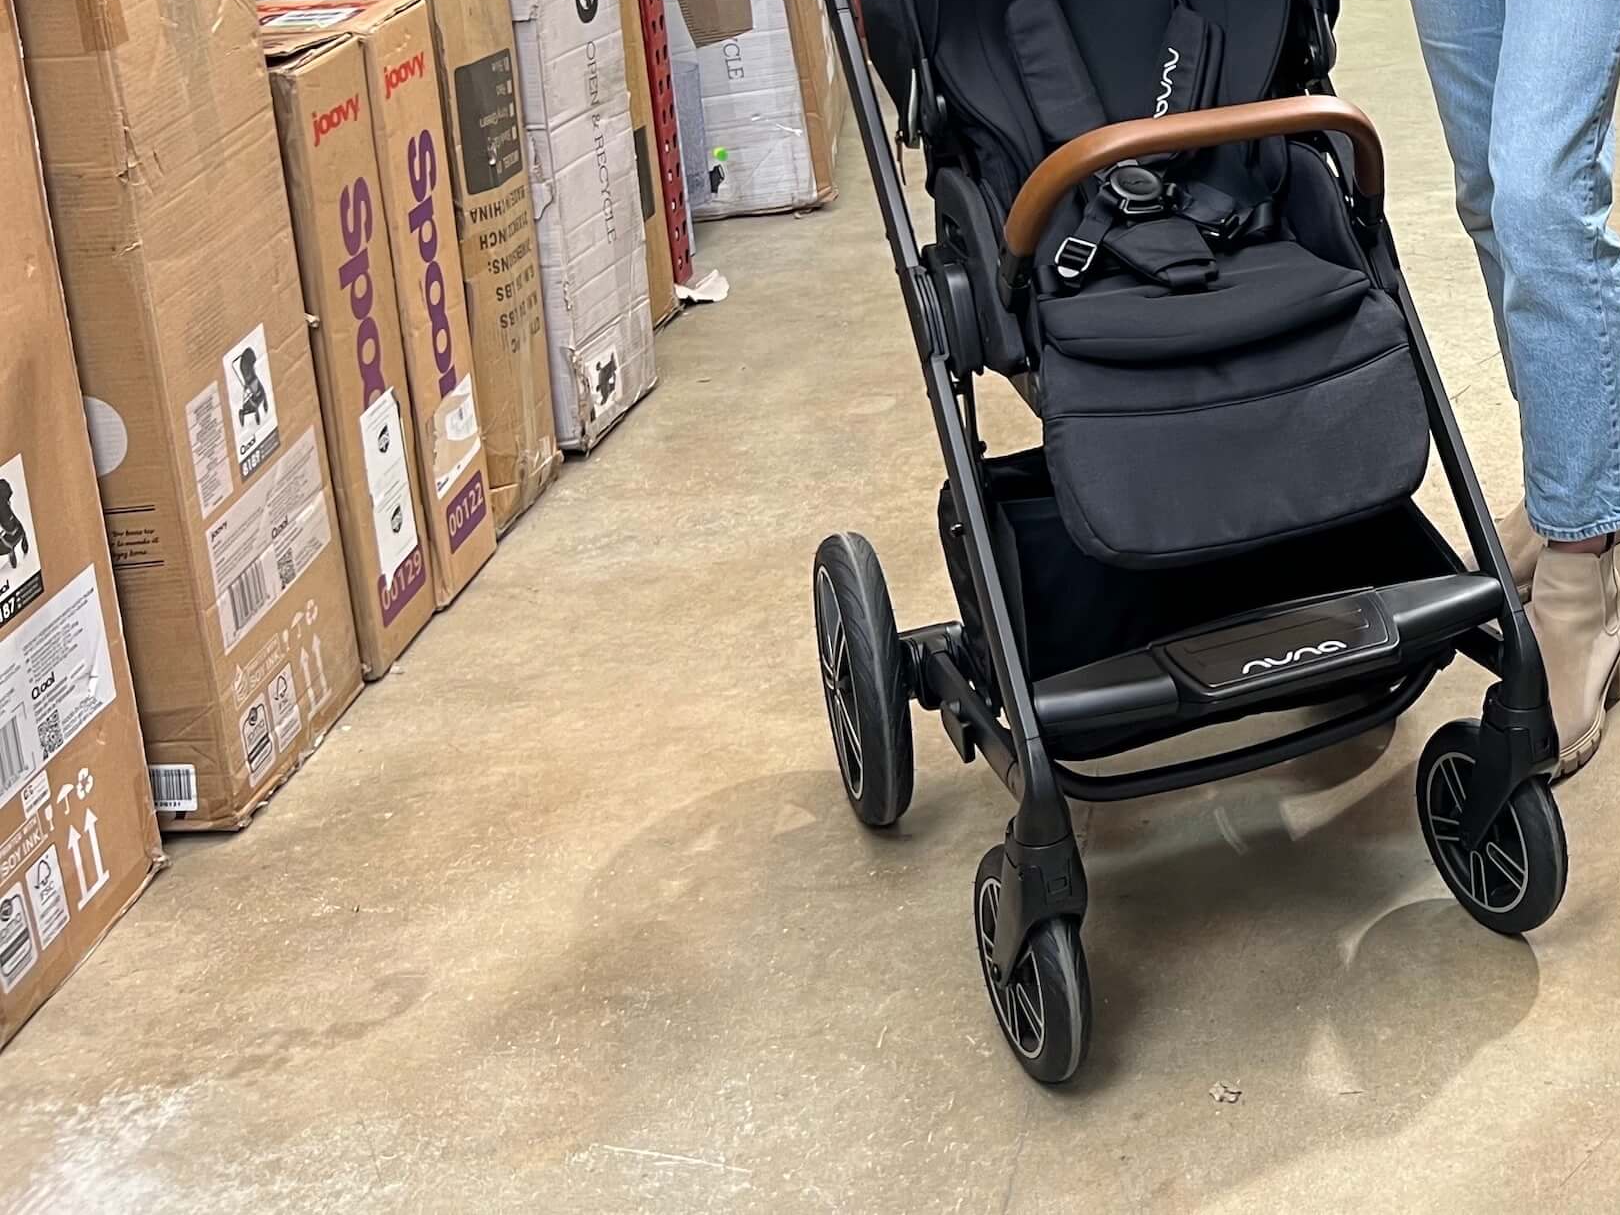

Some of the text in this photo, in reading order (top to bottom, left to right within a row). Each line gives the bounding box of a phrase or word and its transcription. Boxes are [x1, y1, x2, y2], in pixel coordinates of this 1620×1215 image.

[384, 51, 426, 99] joovy
[1153, 47, 1180, 119] nuna
[312, 94, 361, 147] joovy
[586, 41, 617, 245] OPEN & RECYCLE
[449, 481, 484, 537] 00122
[381, 549, 422, 611] 00129
[1241, 639, 1348, 676] nuna
[31, 671, 56, 700] Qool
[1, 850, 22, 877] SOY
[22, 831, 42, 857] INK
